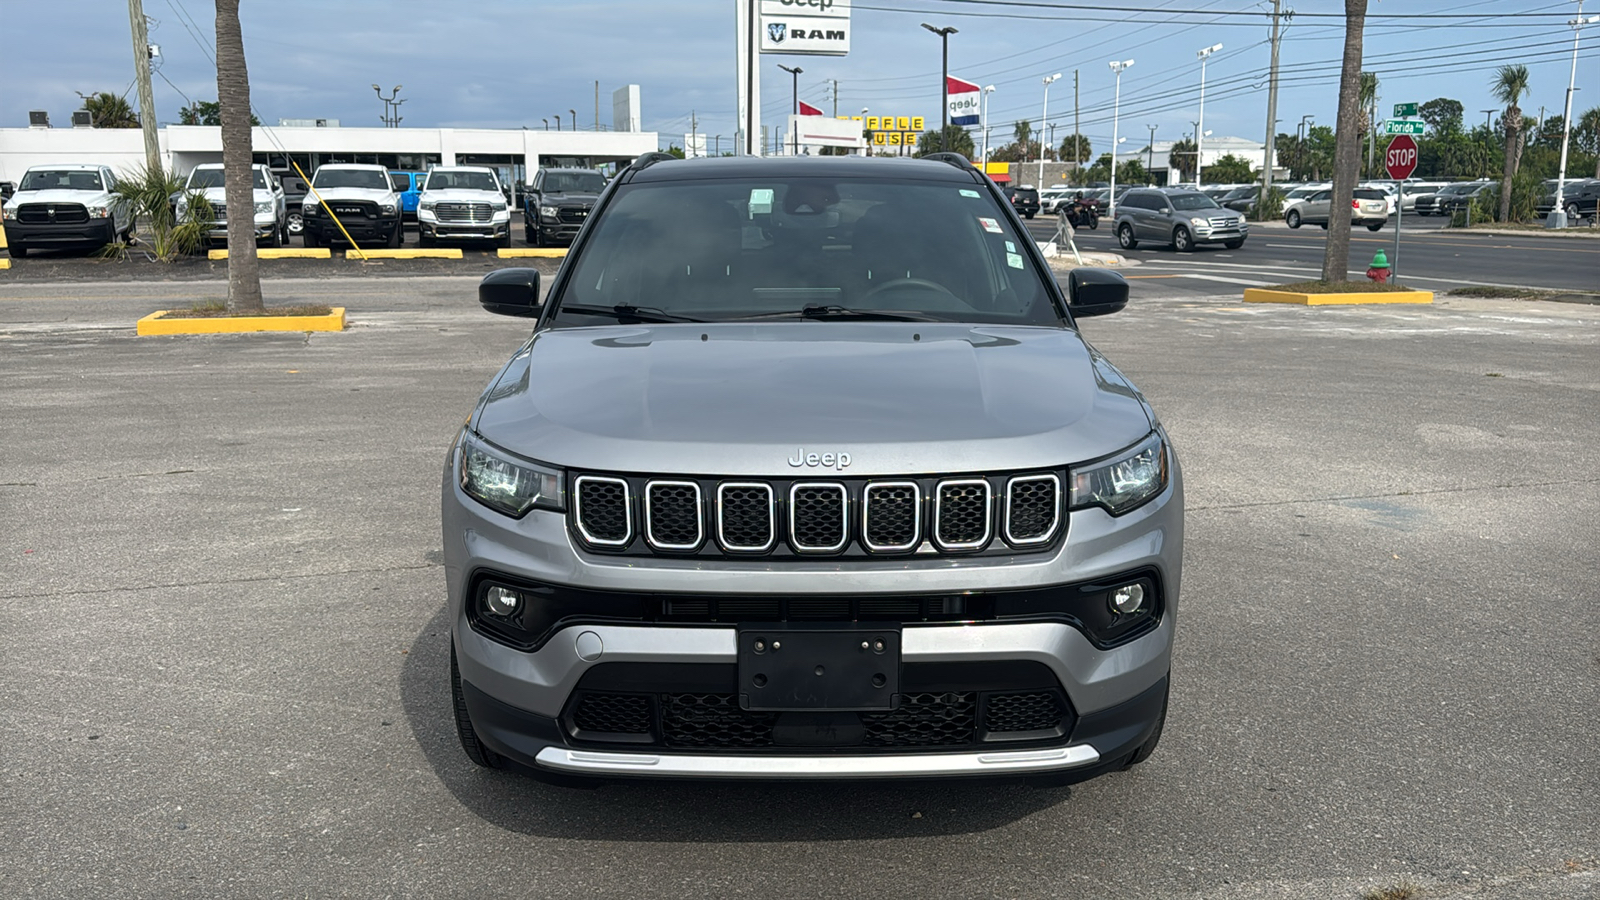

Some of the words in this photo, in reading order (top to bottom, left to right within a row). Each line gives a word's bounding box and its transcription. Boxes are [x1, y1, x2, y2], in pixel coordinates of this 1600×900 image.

[791, 29, 845, 40] RAM
[1394, 105, 1407, 116] 15th
[1386, 121, 1414, 132] Florida
[1387, 148, 1415, 167] STOP
[788, 448, 852, 471] Jeep
